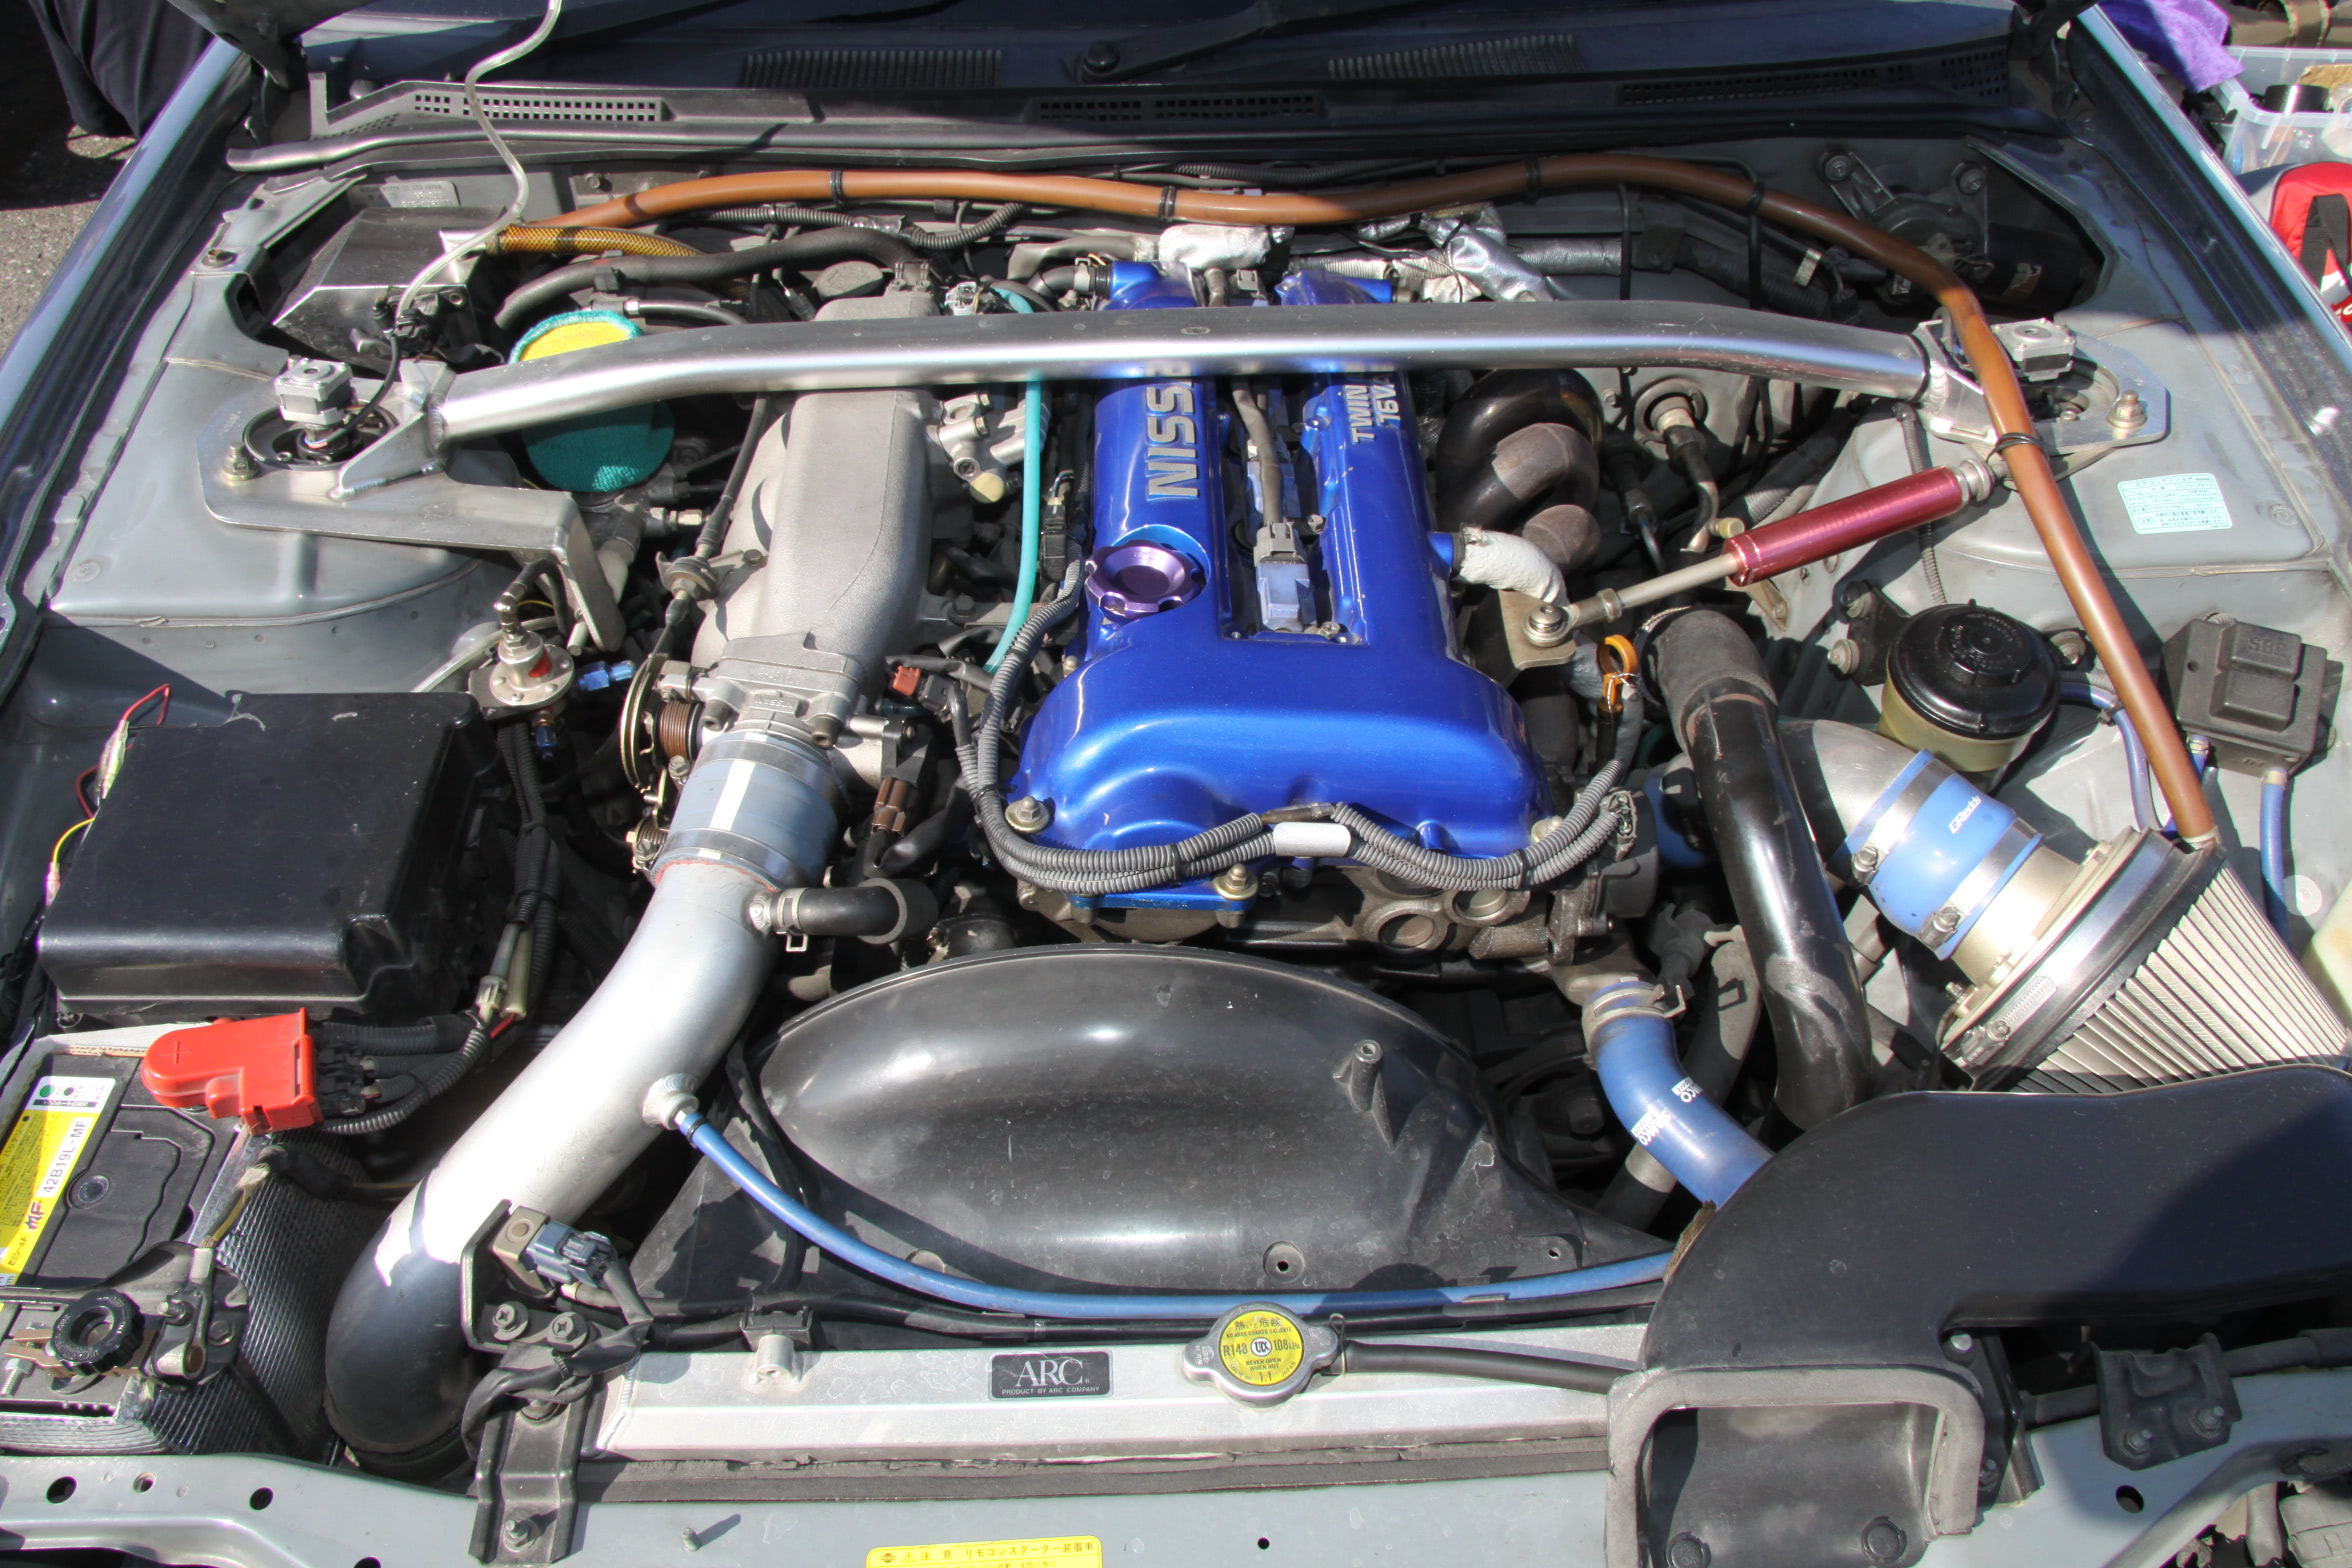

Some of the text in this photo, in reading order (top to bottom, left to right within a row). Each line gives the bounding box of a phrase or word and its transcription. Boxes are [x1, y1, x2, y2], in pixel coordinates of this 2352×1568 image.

[1344, 384, 1376, 444] TWIN
[1146, 378, 1200, 501] NISS
[43, 1120, 88, 1194] 42B19L-MF
[24, 1200, 45, 1230] MF
[1223, 1342, 1248, 1357] R148
[1245, 1358, 1265, 1366] NEVER
[1014, 1358, 1083, 1387] ARC
[1249, 1364, 1267, 1372] WHEN
[1258, 1371, 1272, 1382] 1.1
